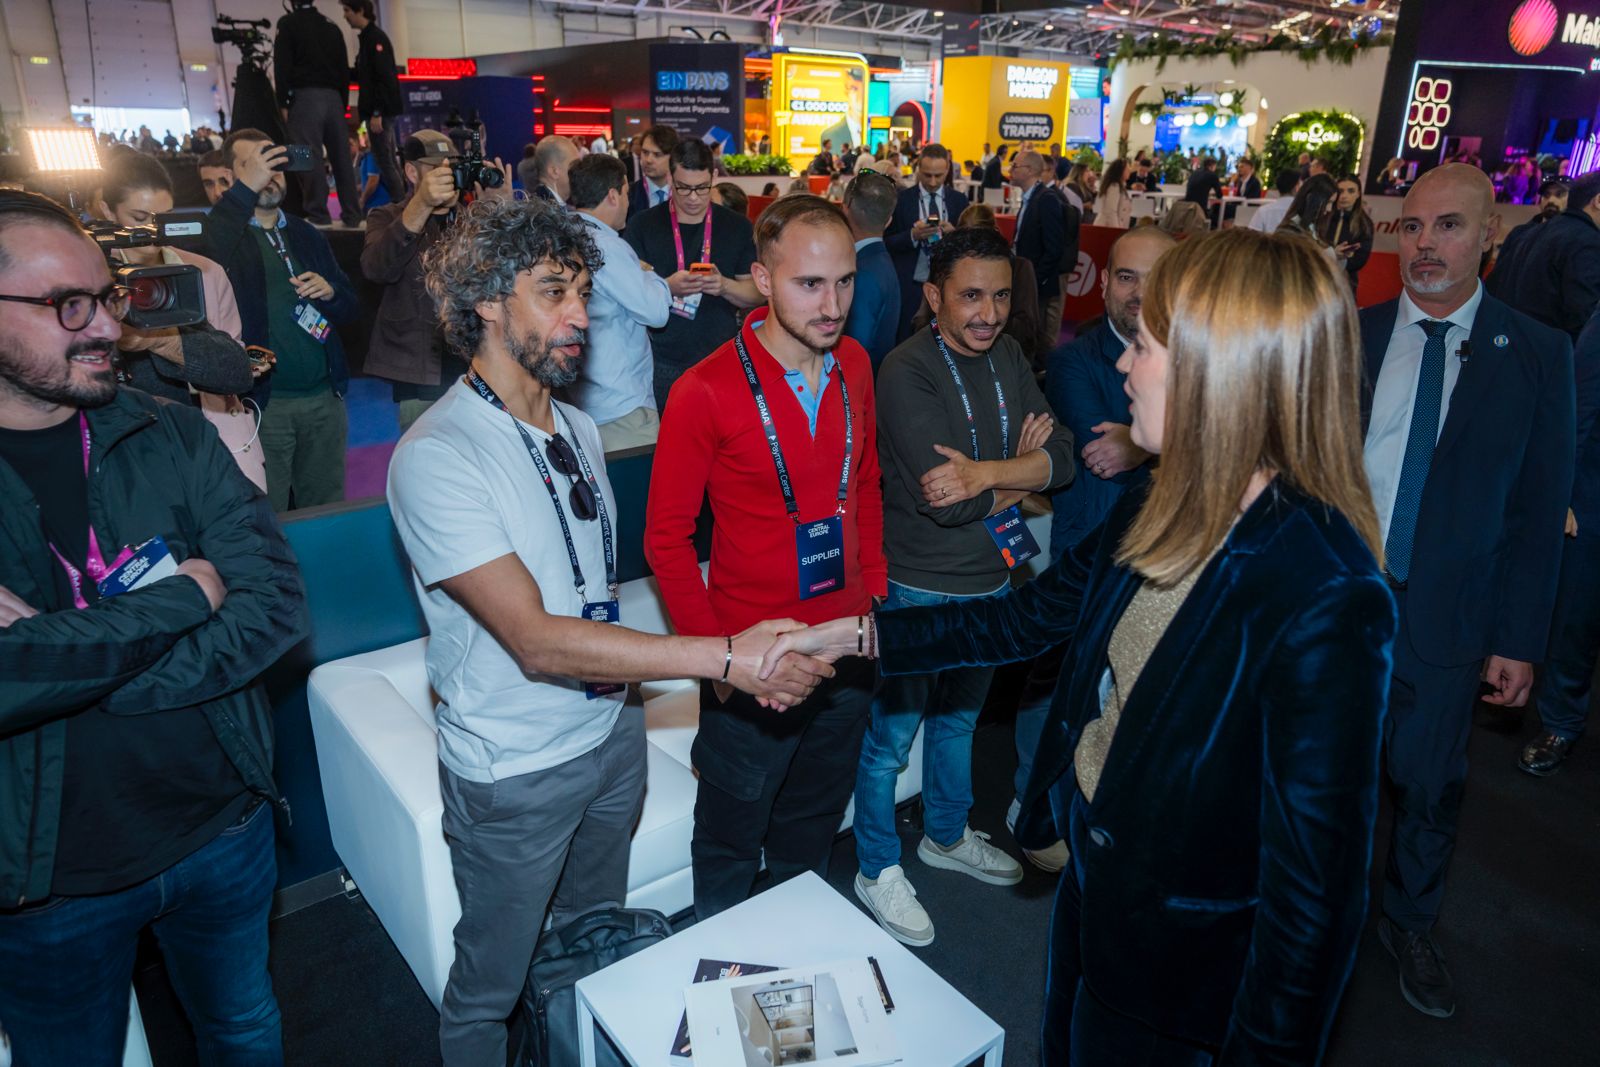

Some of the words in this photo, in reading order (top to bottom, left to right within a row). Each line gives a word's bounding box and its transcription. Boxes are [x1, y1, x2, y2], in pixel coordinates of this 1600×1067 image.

[1007, 65, 1058, 85] DRAGON
[1009, 81, 1053, 99] MONEY
[655, 96, 681, 104] Unlock
[683, 96, 695, 104] the
[697, 96, 721, 105] Power
[655, 105, 663, 113] of
[692, 105, 730, 115] Payments
[1002, 124, 1050, 138] TRAFFIC
[743, 363, 758, 385] Center
[770, 441, 786, 474] Payment
[780, 474, 792, 497] Center
[598, 500, 611, 537] Payment
[808, 524, 831, 534] CENTRAL
[809, 528, 829, 539] EUROPE
[566, 539, 579, 567] Center
[604, 537, 613, 564] Center
[801, 548, 841, 566] SUPPLIER
[118, 556, 150, 583] CENTRAL
[122, 562, 151, 587] EUROPE
[591, 609, 609, 617] CENTRAL
